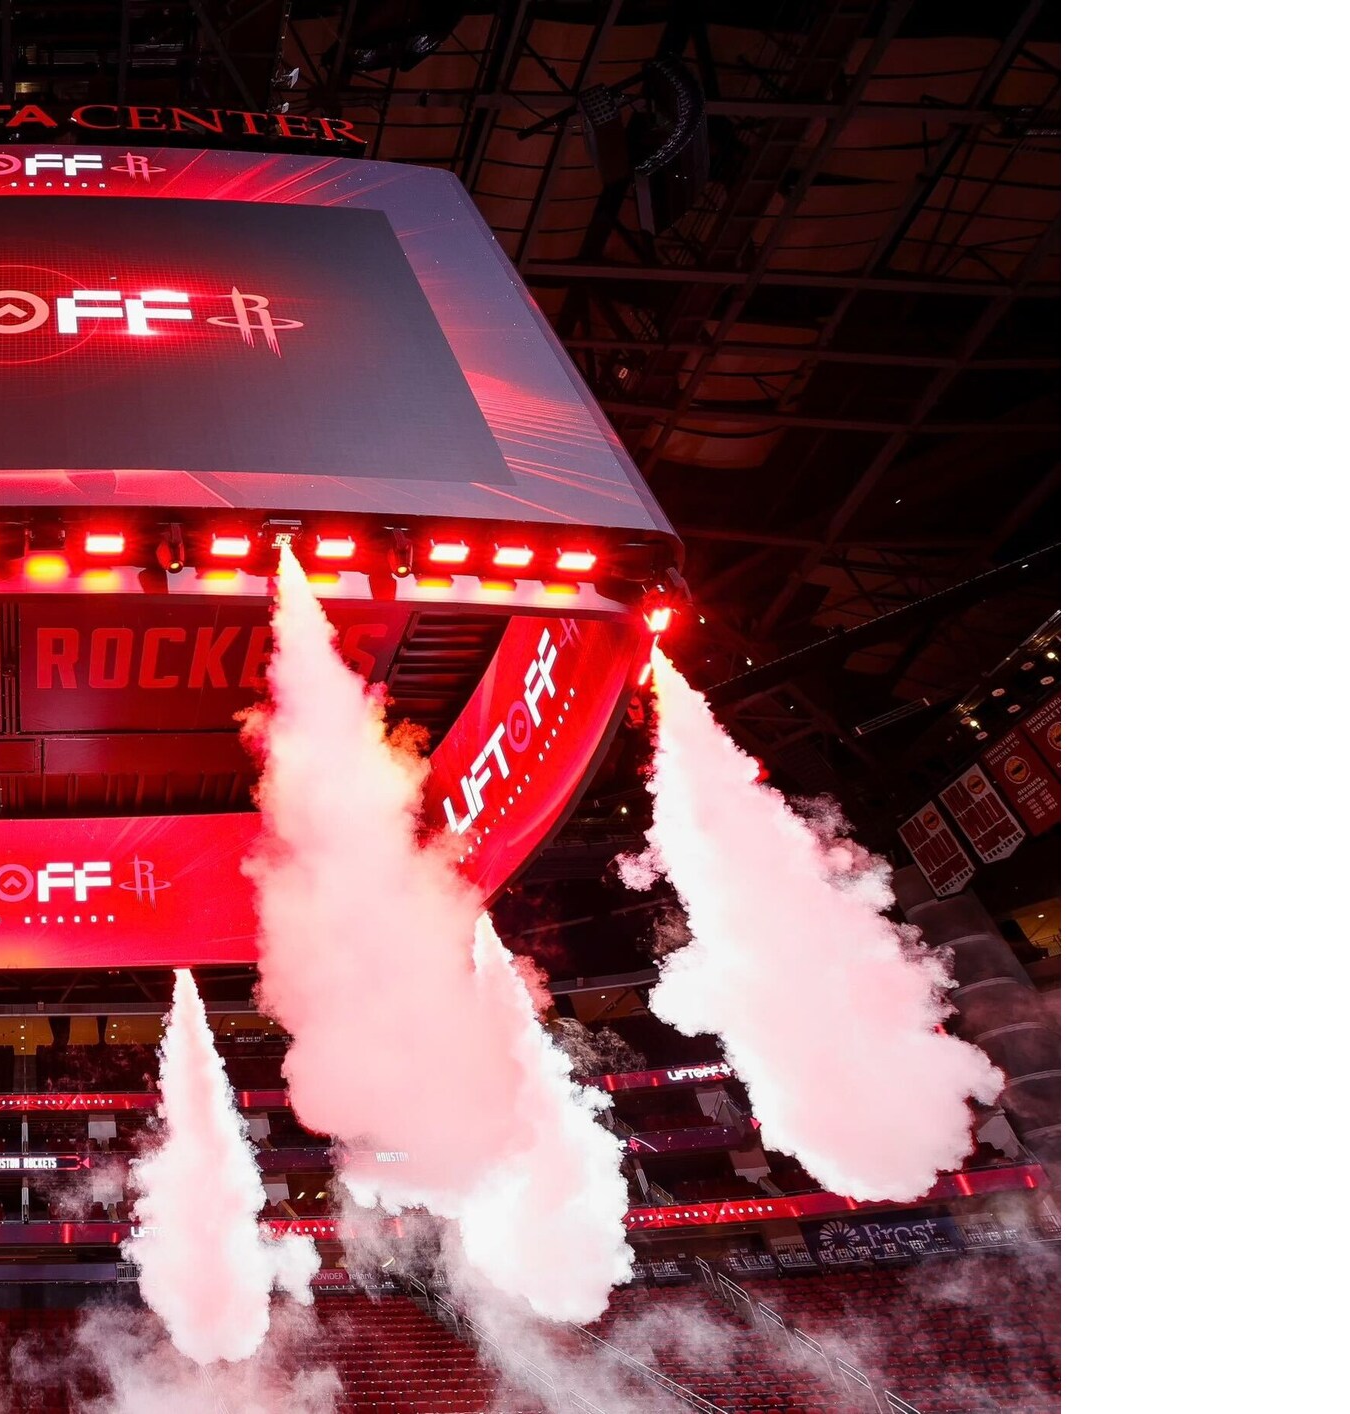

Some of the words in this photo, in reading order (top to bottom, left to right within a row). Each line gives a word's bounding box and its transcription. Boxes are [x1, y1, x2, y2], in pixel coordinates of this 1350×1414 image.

[69, 104, 368, 144] CENTER
[442, 627, 558, 836] LIFTOFF
[376, 1151, 410, 1163] HOUSTON
[861, 1219, 937, 1249] Frost
